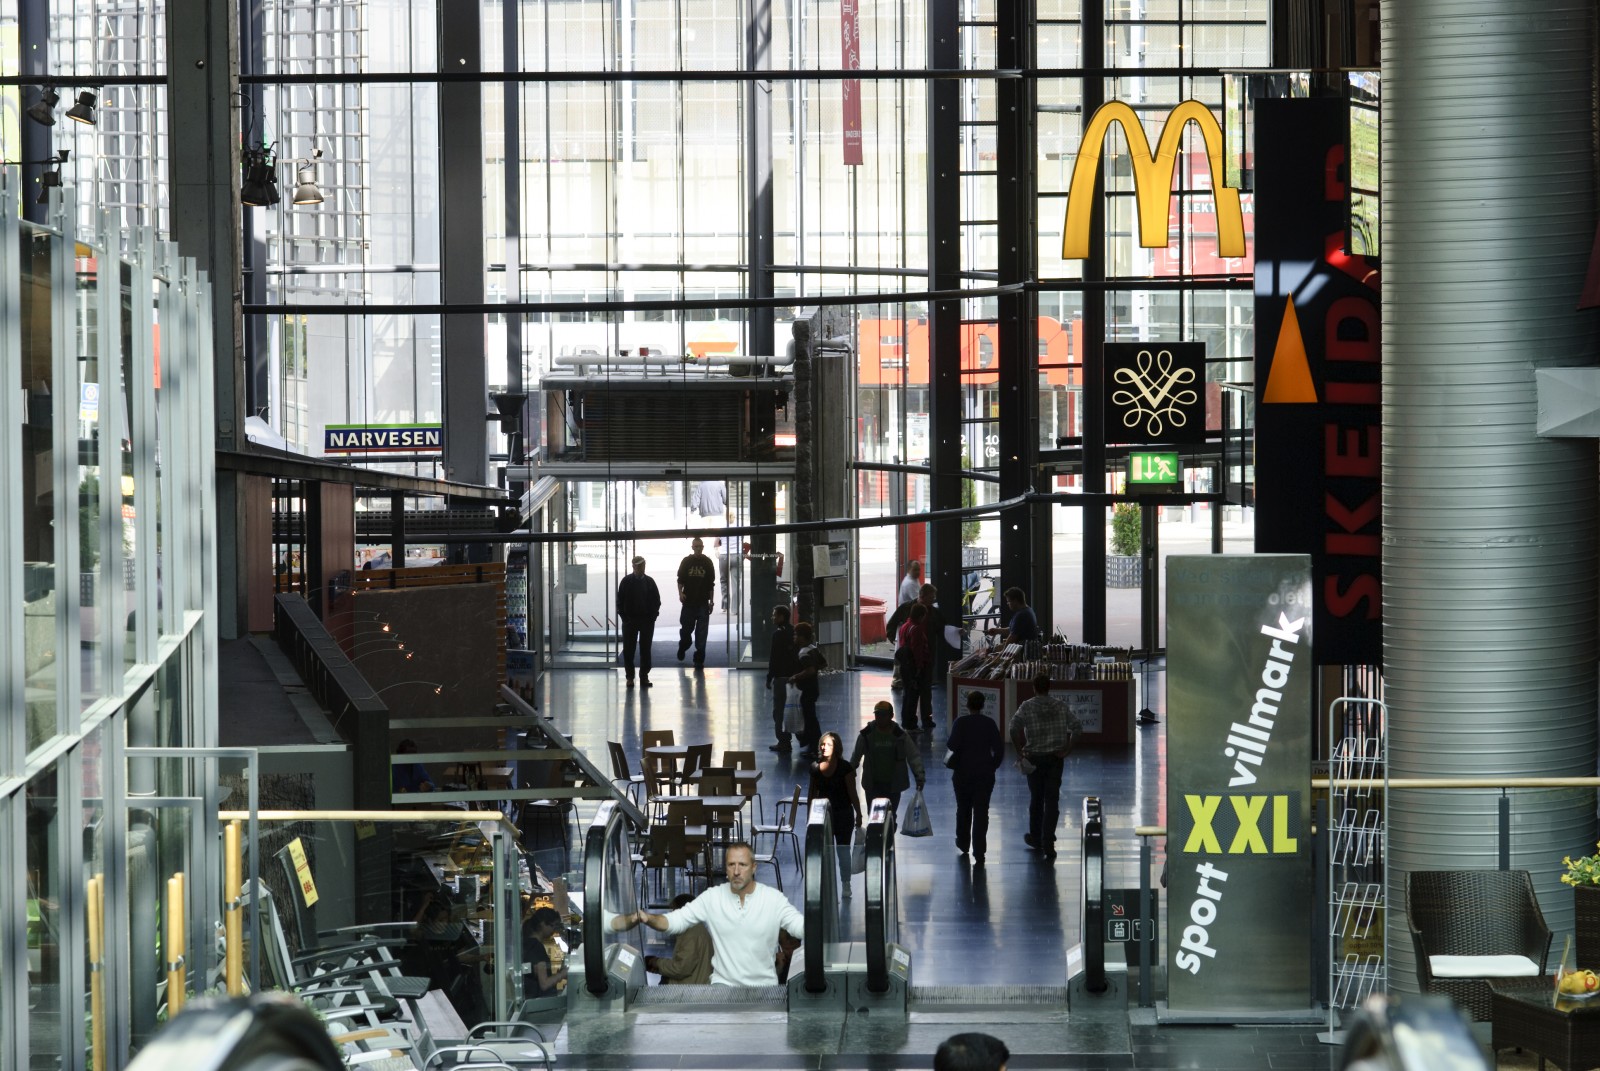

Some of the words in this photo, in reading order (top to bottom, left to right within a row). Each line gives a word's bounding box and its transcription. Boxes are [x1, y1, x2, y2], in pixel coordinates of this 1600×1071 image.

[330, 431, 439, 447] NARVESEN
[1224, 611, 1305, 787] villmark
[1183, 795, 1298, 854] XXL
[1175, 861, 1229, 975] sport
